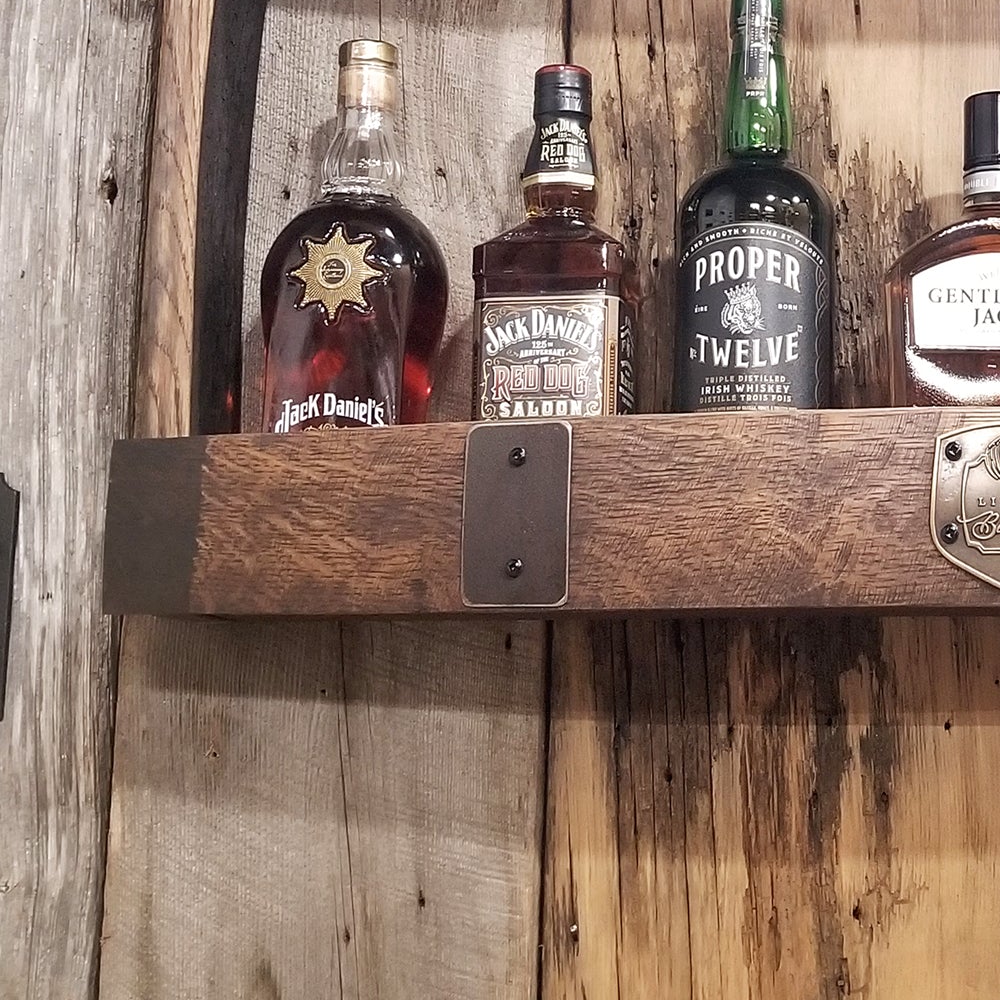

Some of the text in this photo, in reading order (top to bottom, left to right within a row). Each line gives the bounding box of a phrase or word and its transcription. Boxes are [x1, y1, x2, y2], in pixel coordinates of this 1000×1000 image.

[540, 122, 559, 140] JACK
[540, 143, 586, 162] RED DOG
[690, 239, 704, 252] AND
[704, 227, 740, 243] SMOOTH
[750, 228, 778, 238] RICHE
[780, 233, 792, 243] ET
[694, 245, 801, 293] PROPER
[777, 302, 798, 312] BORN
[483, 315, 529, 357] JACK
[518, 349, 568, 358] ANNIVERSARY
[695, 331, 800, 368] TWELVE
[490, 364, 542, 401] RED
[542, 363, 589, 397] DOG
[704, 373, 787, 384] TRIPLE DISTILLED
[700, 383, 791, 395] IRISH WHISKEY
[739, 394, 769, 403] TROIS
[770, 394, 793, 403] FOIS
[322, 393, 389, 428] Daniel's
[499, 400, 584, 417] SALOON
